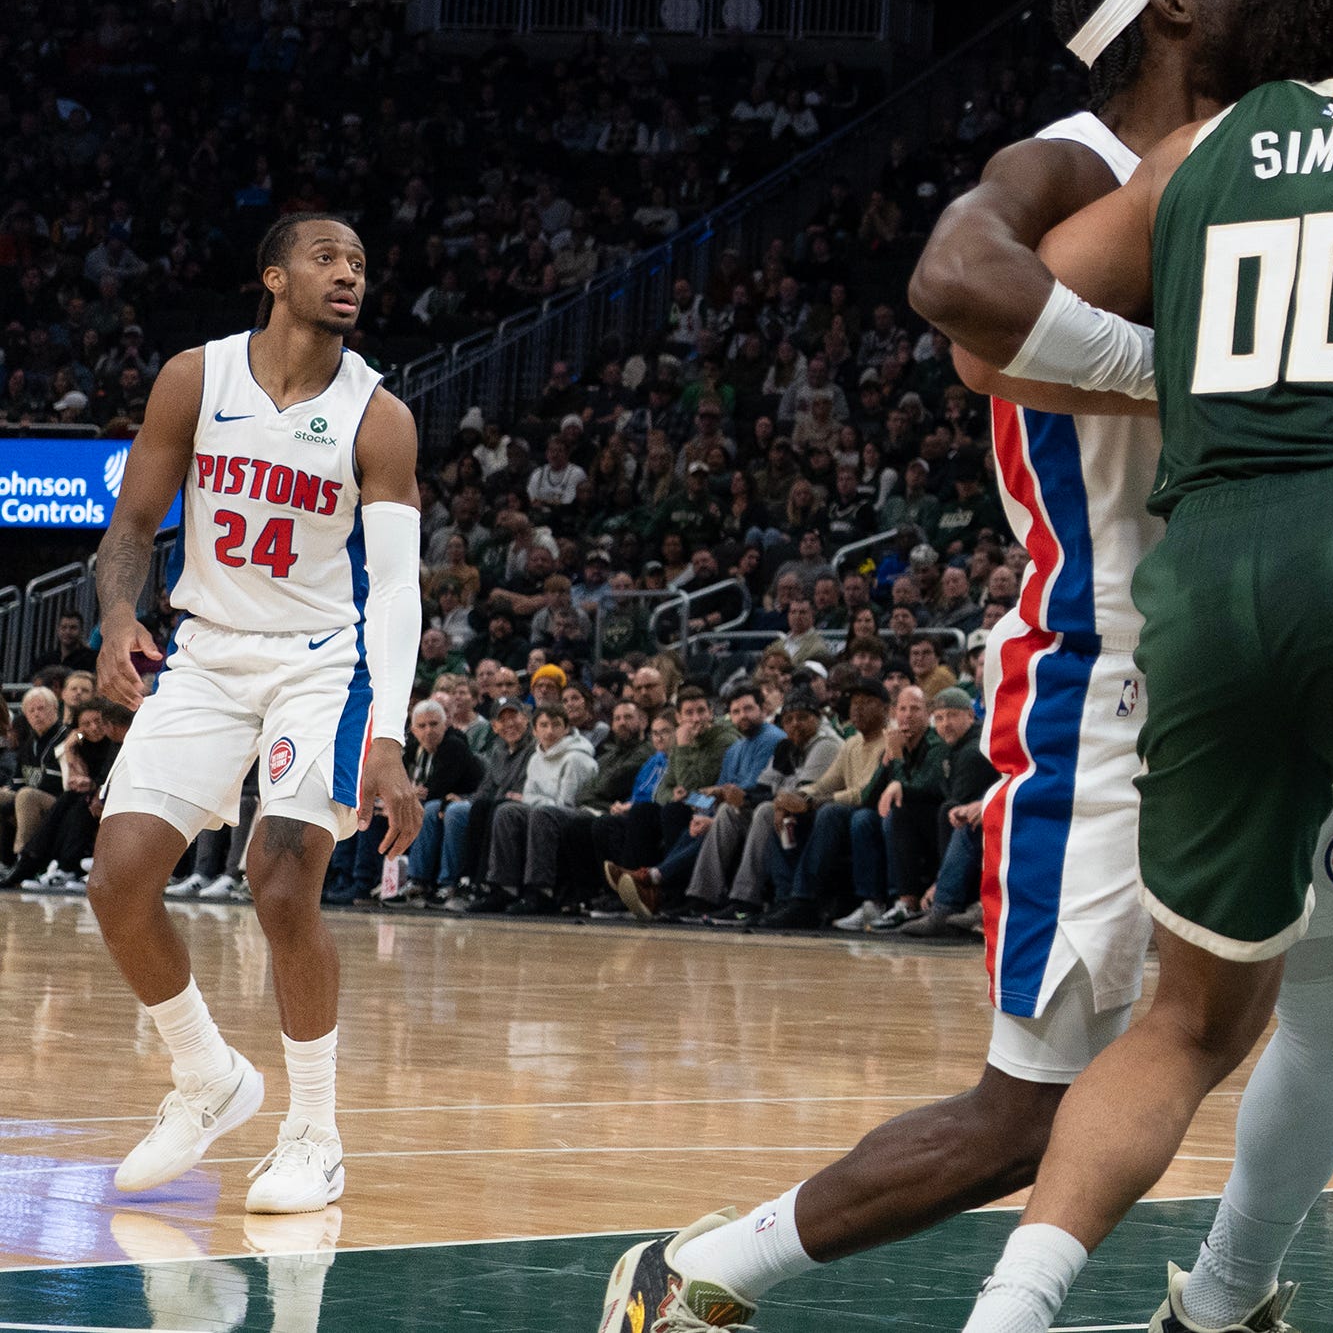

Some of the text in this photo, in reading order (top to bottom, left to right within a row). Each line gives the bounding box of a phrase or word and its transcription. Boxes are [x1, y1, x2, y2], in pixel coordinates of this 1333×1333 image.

[294, 430, 337, 447] StockX
[0, 472, 86, 497] ohnson
[195, 452, 343, 516] PISTONS
[2, 498, 104, 523] Controls
[214, 509, 298, 578] 24
